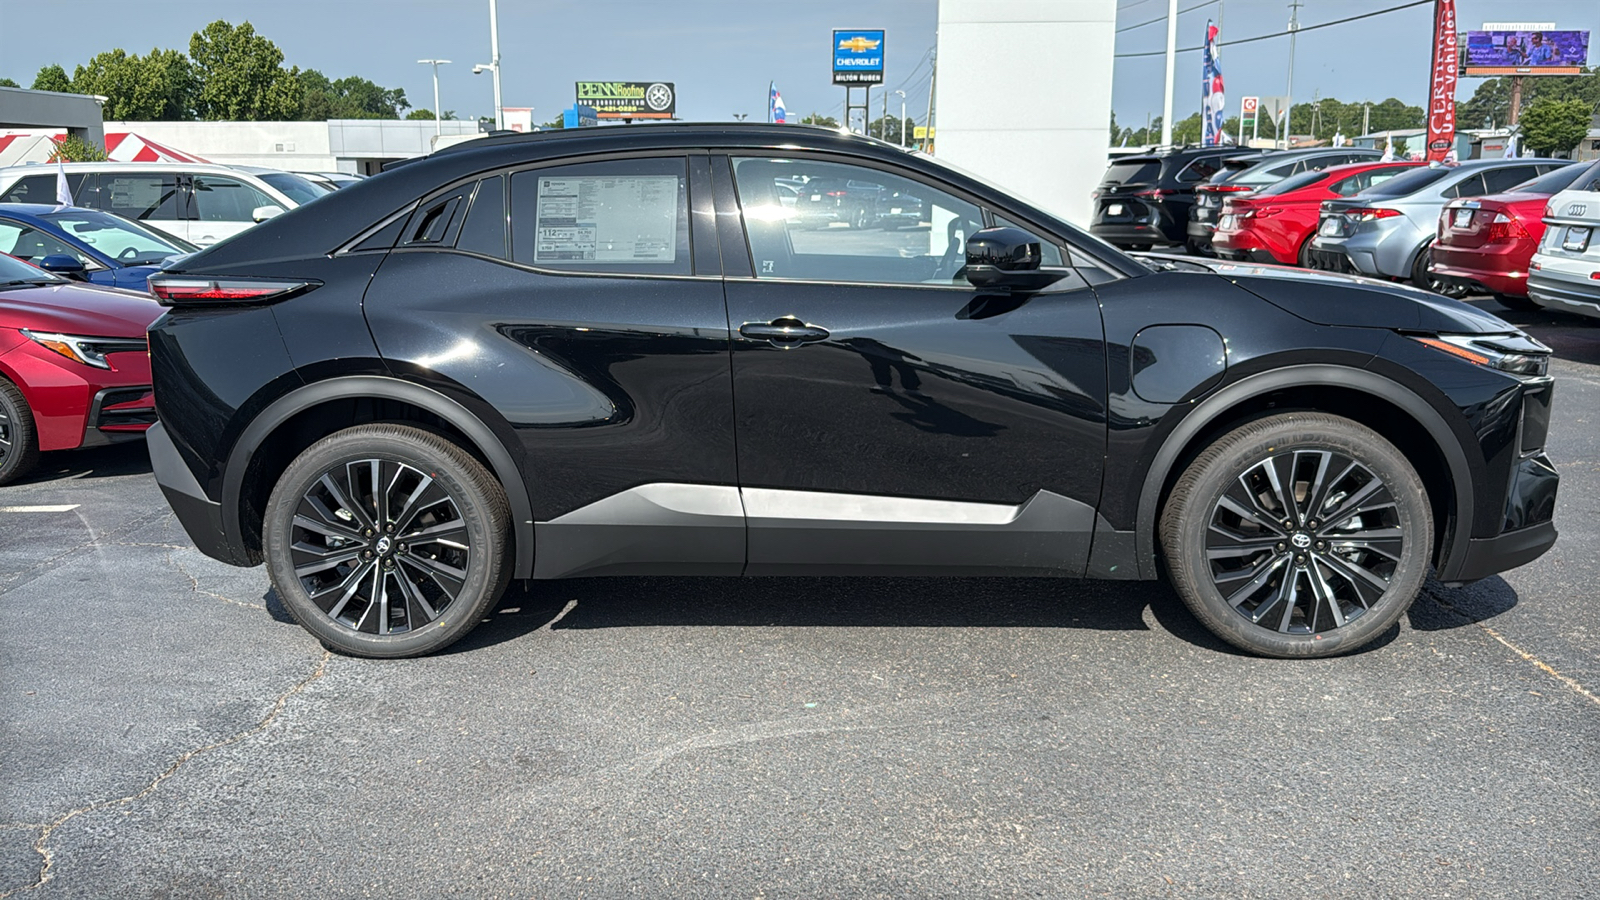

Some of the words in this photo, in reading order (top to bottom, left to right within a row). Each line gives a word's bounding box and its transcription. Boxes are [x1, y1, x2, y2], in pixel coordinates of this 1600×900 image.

[836, 58, 880, 66] CHEVROLET
[835, 74, 858, 82] MILTON
[859, 74, 881, 82] RUBEN
[578, 82, 621, 97] PENN
[617, 84, 645, 99] Roofing
